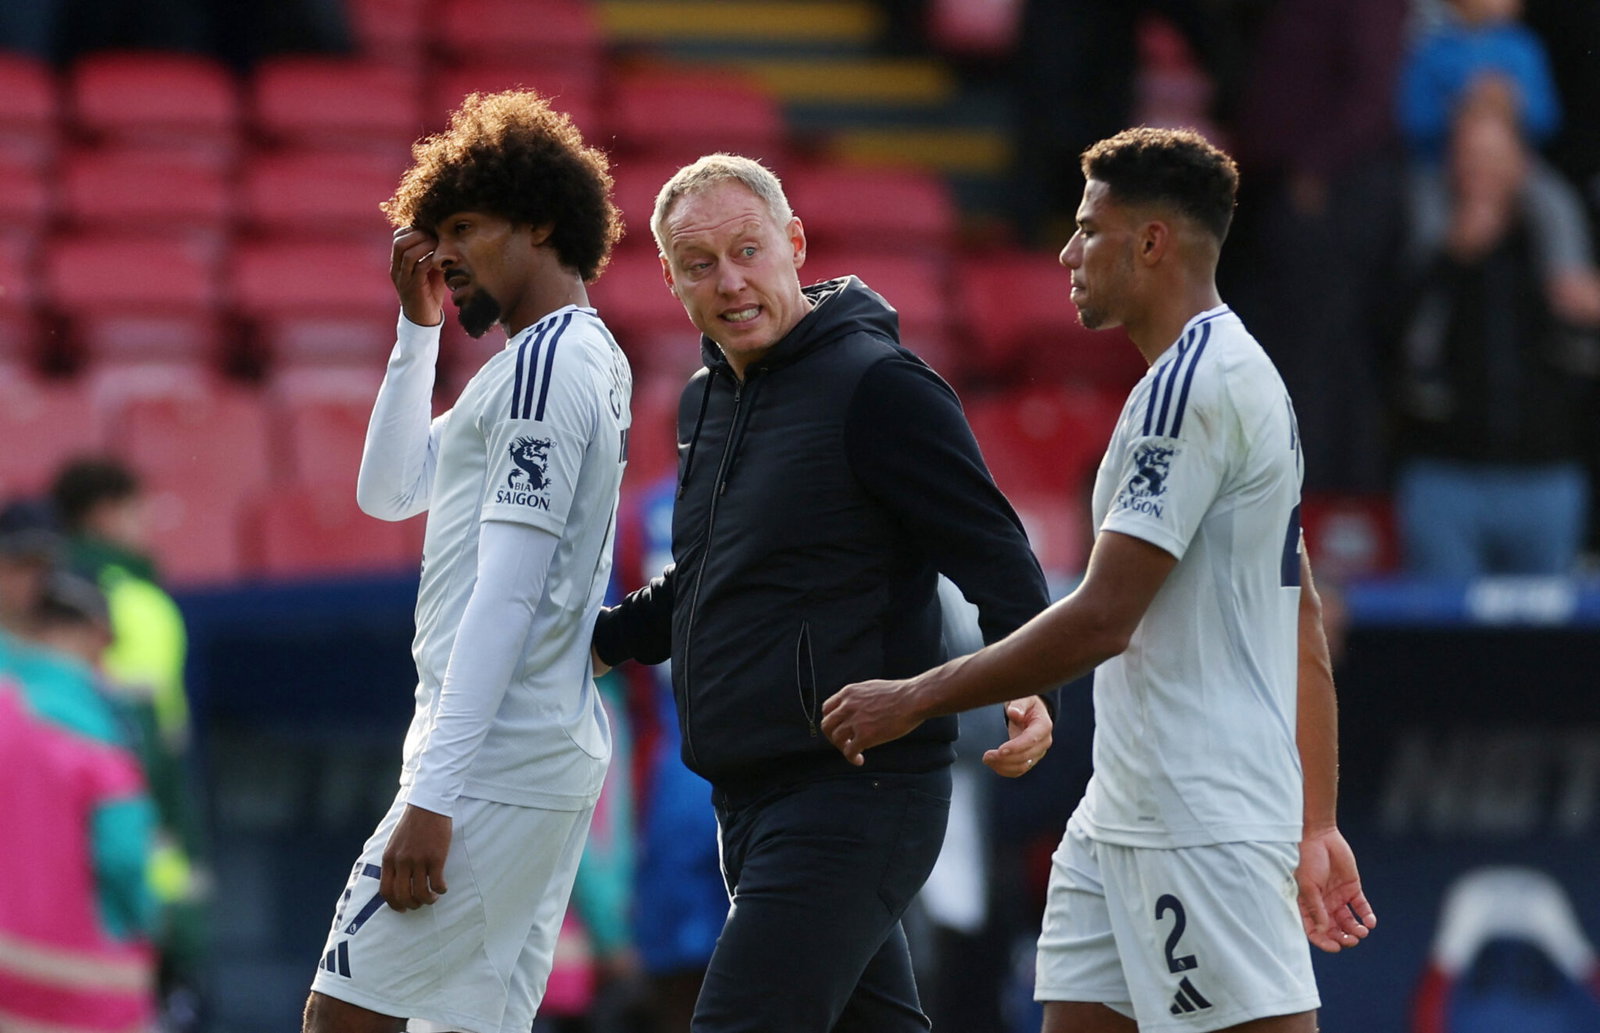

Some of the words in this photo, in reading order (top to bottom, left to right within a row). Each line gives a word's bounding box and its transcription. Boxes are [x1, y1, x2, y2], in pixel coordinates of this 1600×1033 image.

[514, 482, 531, 492] BIA
[496, 490, 551, 511] SAIGON
[1155, 893, 1199, 974] 2
